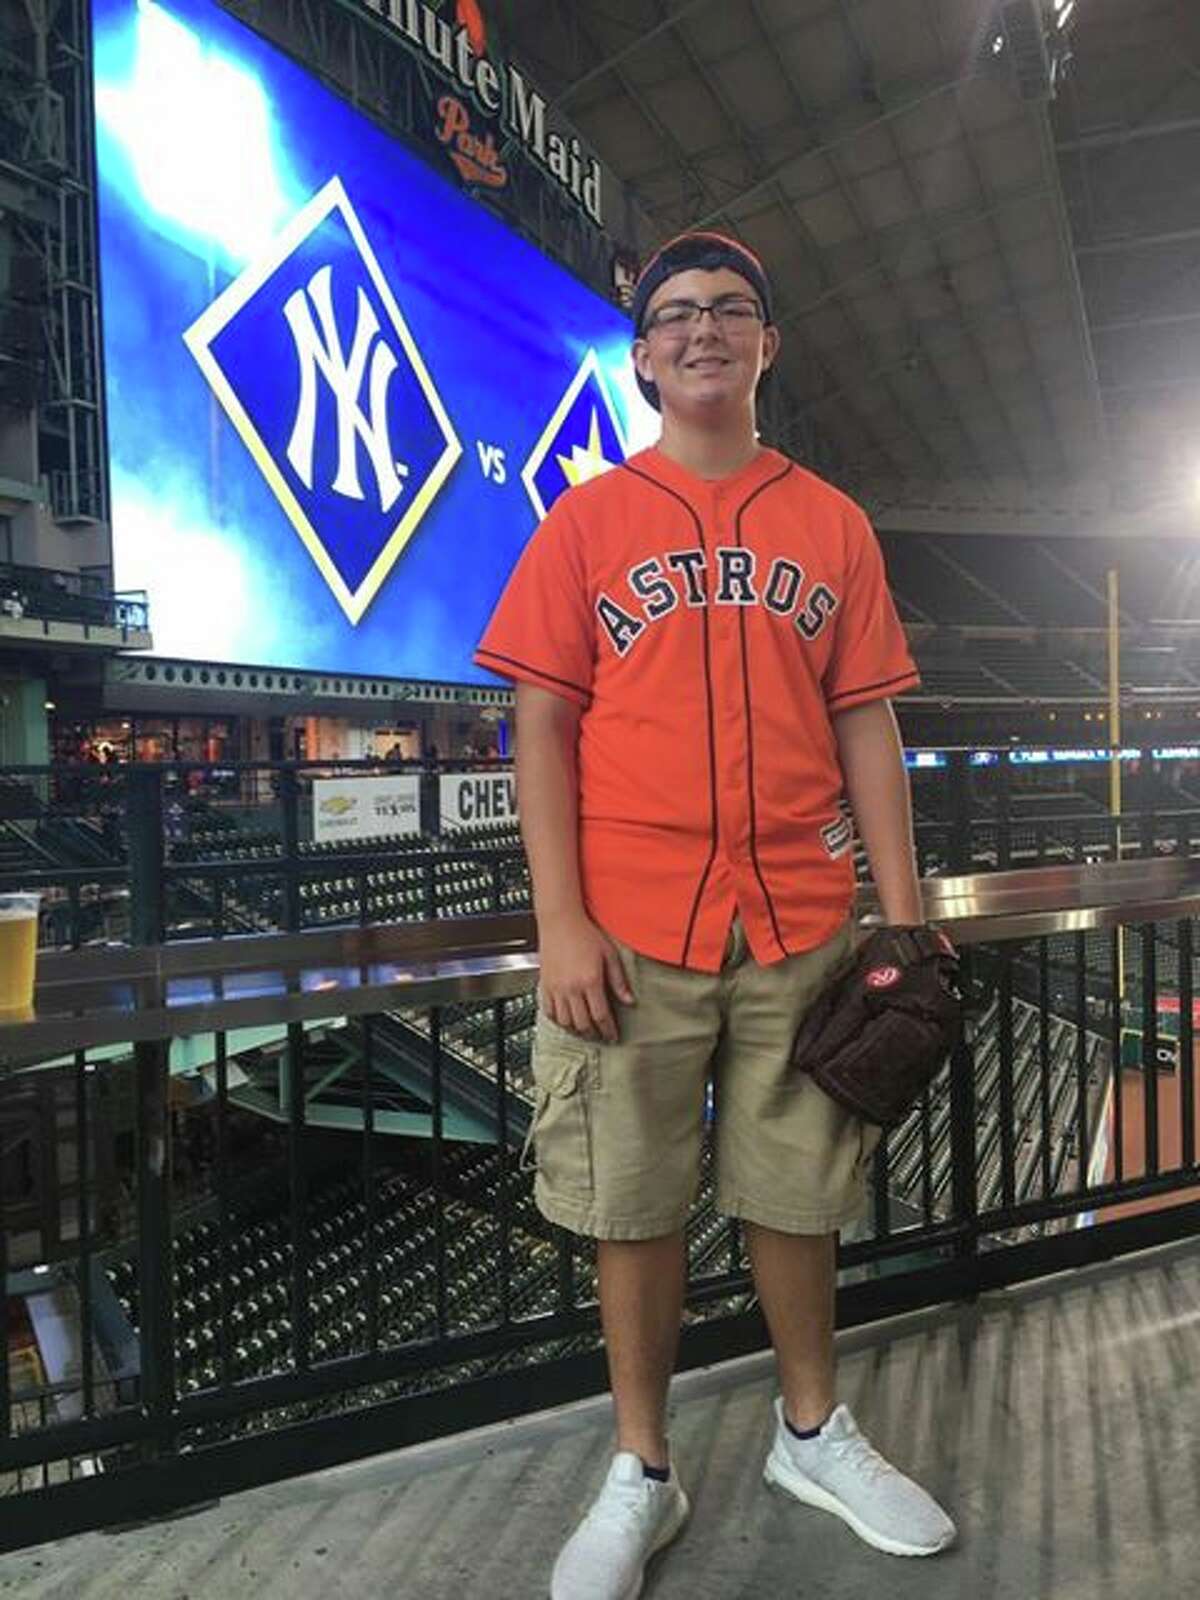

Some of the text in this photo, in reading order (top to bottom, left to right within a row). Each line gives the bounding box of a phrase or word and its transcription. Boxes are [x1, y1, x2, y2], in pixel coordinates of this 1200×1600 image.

[434, 96, 505, 176] Park
[509, 64, 604, 227] Maid
[595, 546, 838, 658] ASTROS
